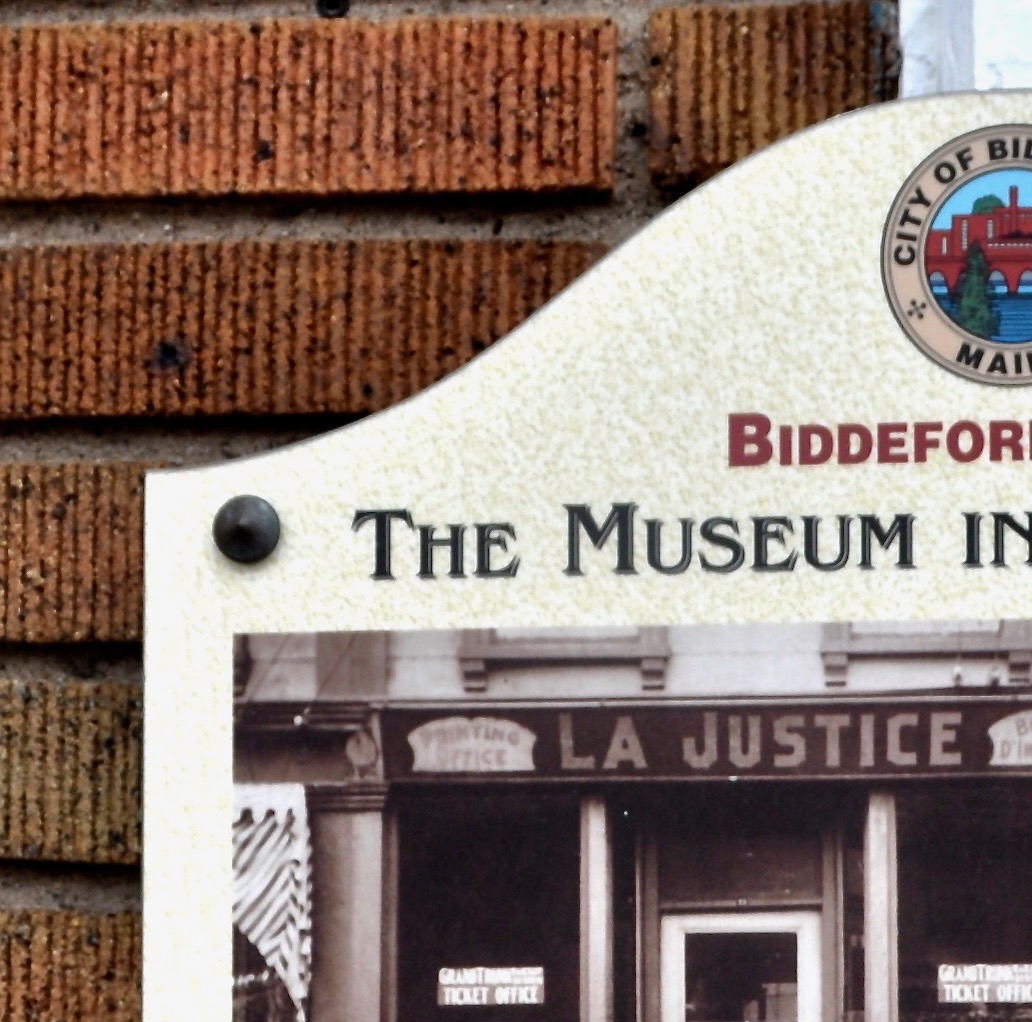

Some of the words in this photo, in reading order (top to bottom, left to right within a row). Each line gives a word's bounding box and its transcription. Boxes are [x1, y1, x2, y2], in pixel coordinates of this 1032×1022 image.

[894, 189, 931, 266] CITY
[934, 147, 975, 184] OF
[351, 508, 521, 582] THE
[562, 502, 917, 578] MUSEUM
[559, 713, 647, 769] LA
[683, 712, 962, 768] JUSTICE
